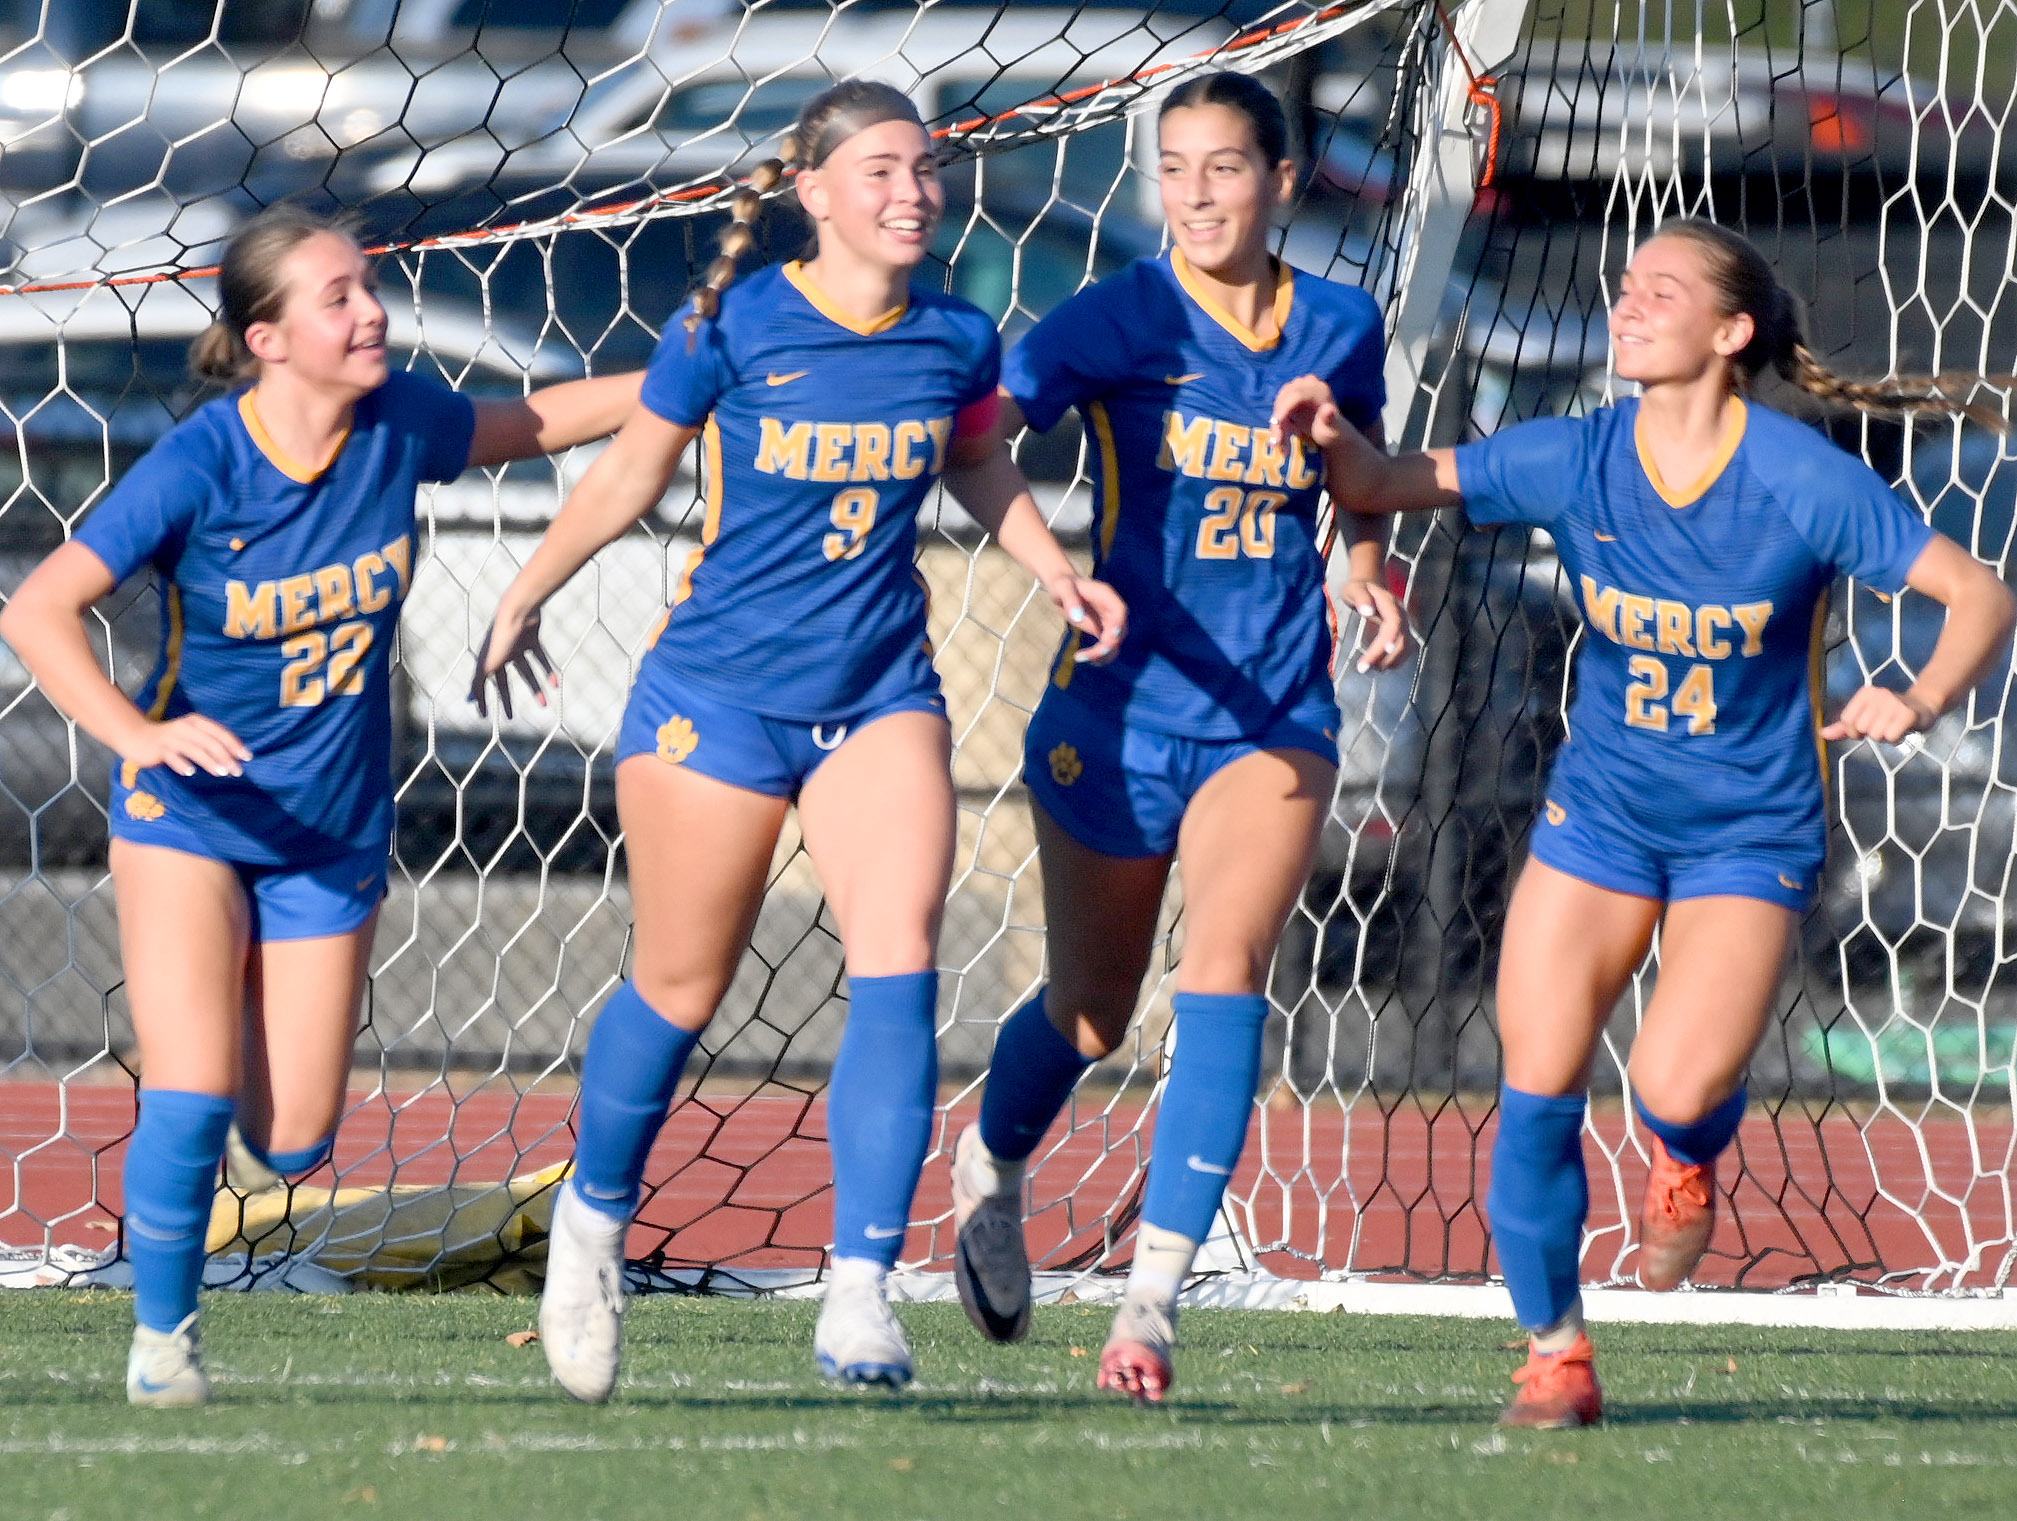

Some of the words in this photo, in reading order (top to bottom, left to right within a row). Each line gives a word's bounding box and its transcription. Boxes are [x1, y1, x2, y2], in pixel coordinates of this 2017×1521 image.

[754, 416, 953, 482] MERCY
[1155, 410, 1326, 489] MERC
[822, 486, 880, 562] 9
[1195, 486, 1289, 560] 20
[1580, 573, 1774, 660] MERCY
[279, 620, 374, 708] 22
[1624, 654, 1717, 736] 24
